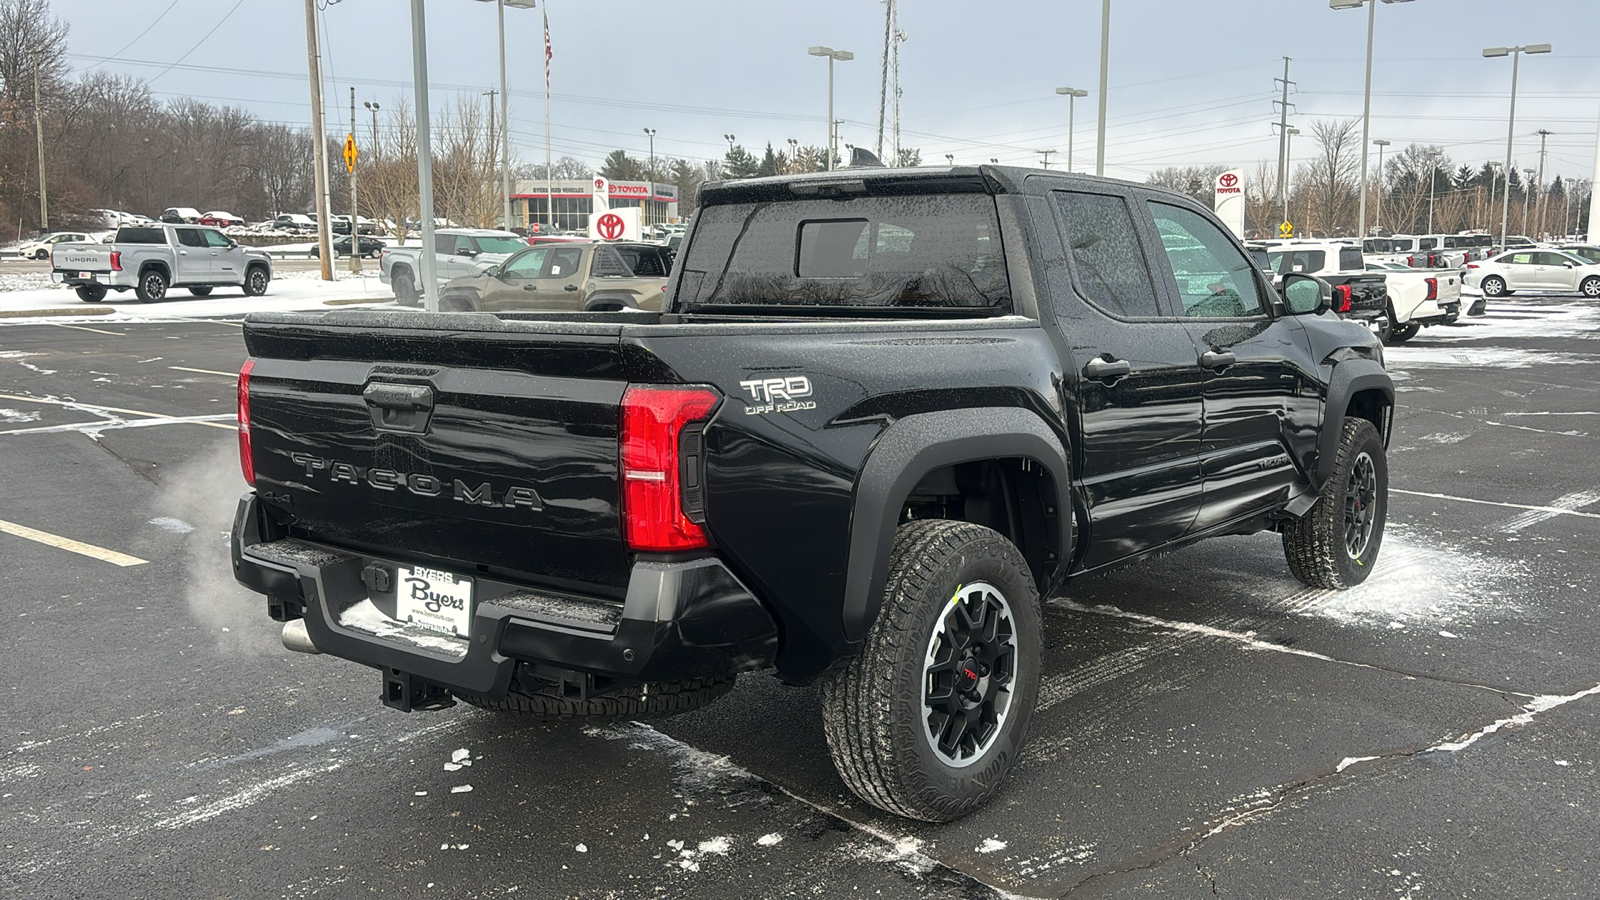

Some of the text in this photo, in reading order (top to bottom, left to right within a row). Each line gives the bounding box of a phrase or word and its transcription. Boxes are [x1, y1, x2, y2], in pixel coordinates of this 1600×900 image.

[617, 185, 649, 193] TOYOTA
[739, 376, 813, 405] TRD
[744, 401, 817, 415] OFF ROAD
[291, 452, 545, 512] TACOMA
[414, 566, 453, 583] BYERS
[404, 577, 464, 612] Byers
[411, 608, 455, 623] www.byersauto.com
